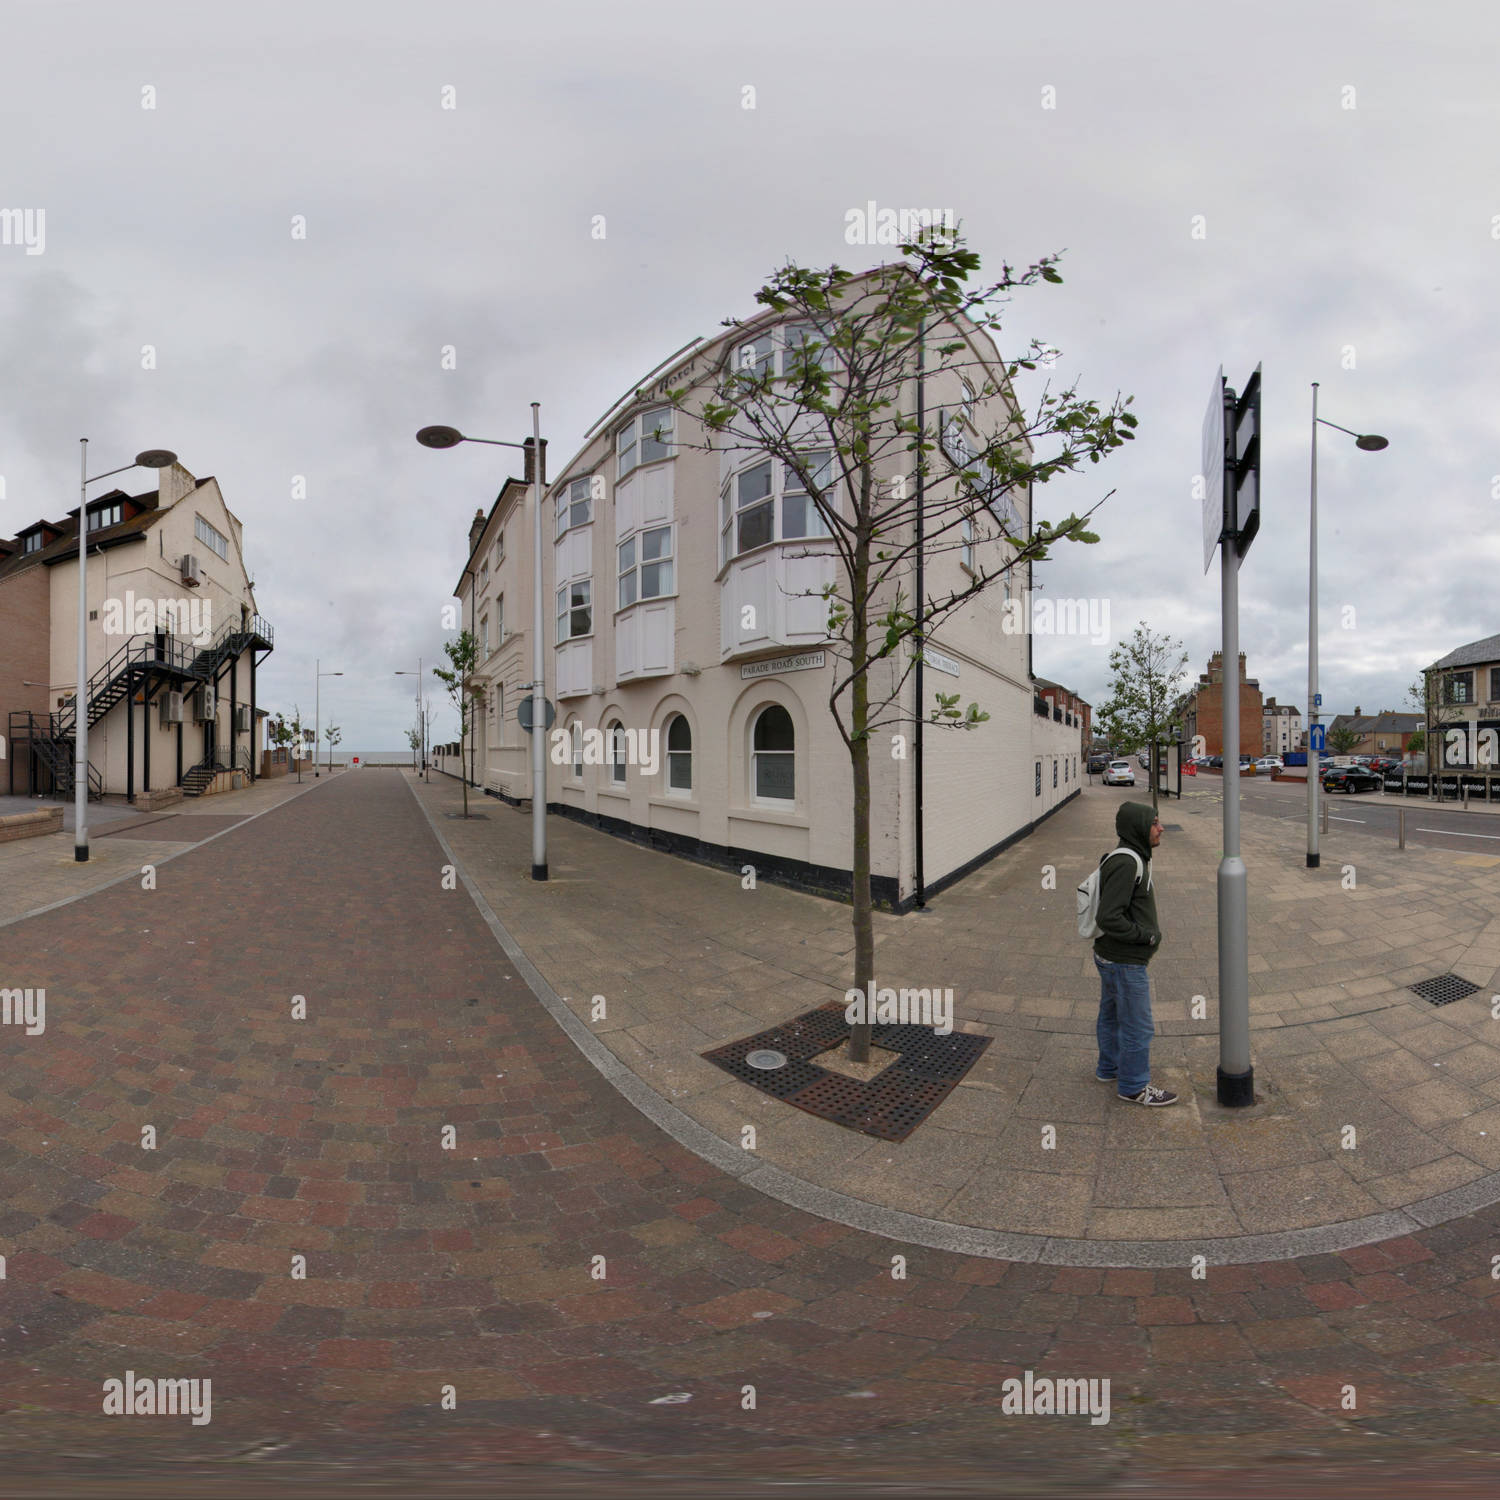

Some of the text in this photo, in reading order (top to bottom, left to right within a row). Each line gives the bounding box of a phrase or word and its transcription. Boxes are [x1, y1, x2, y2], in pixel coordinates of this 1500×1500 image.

[743, 655, 823, 676] PARADE ROAD SOUTH
